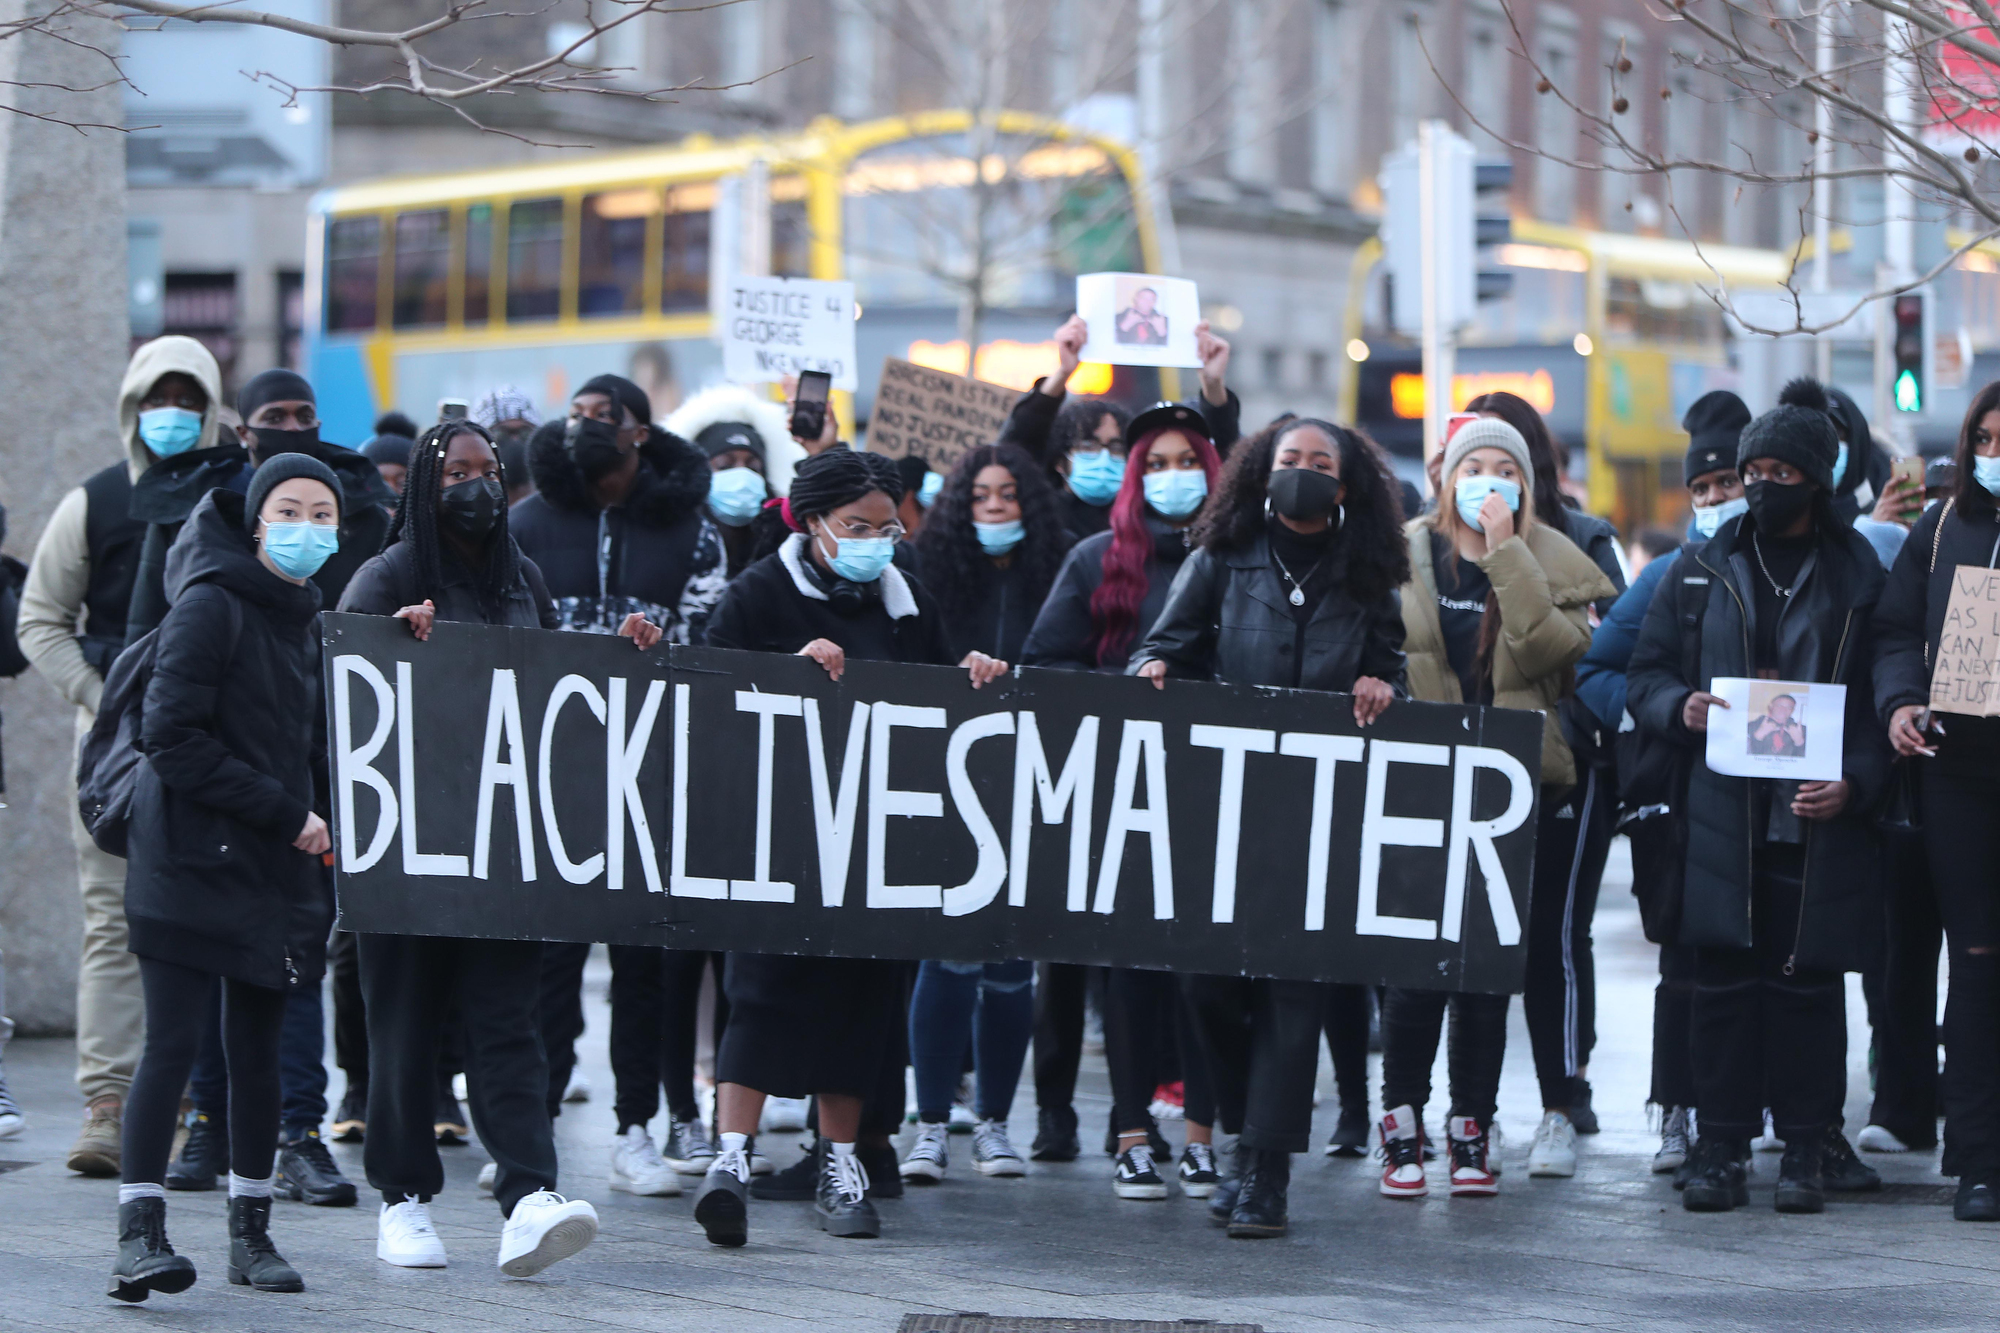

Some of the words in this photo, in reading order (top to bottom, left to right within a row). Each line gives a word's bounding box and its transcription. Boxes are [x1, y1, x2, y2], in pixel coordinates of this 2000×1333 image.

[733, 288, 812, 319] JUSTICE
[825, 296, 841, 323] 4
[732, 316, 804, 346] GEORGE
[880, 383, 925, 411] REAL
[877, 406, 904, 429] NO
[874, 429, 902, 452] NO
[1956, 573, 2000, 602] WE
[1946, 607, 1978, 630] AS
[1940, 633, 1984, 658] CAN
[1938, 657, 1950, 674] A
